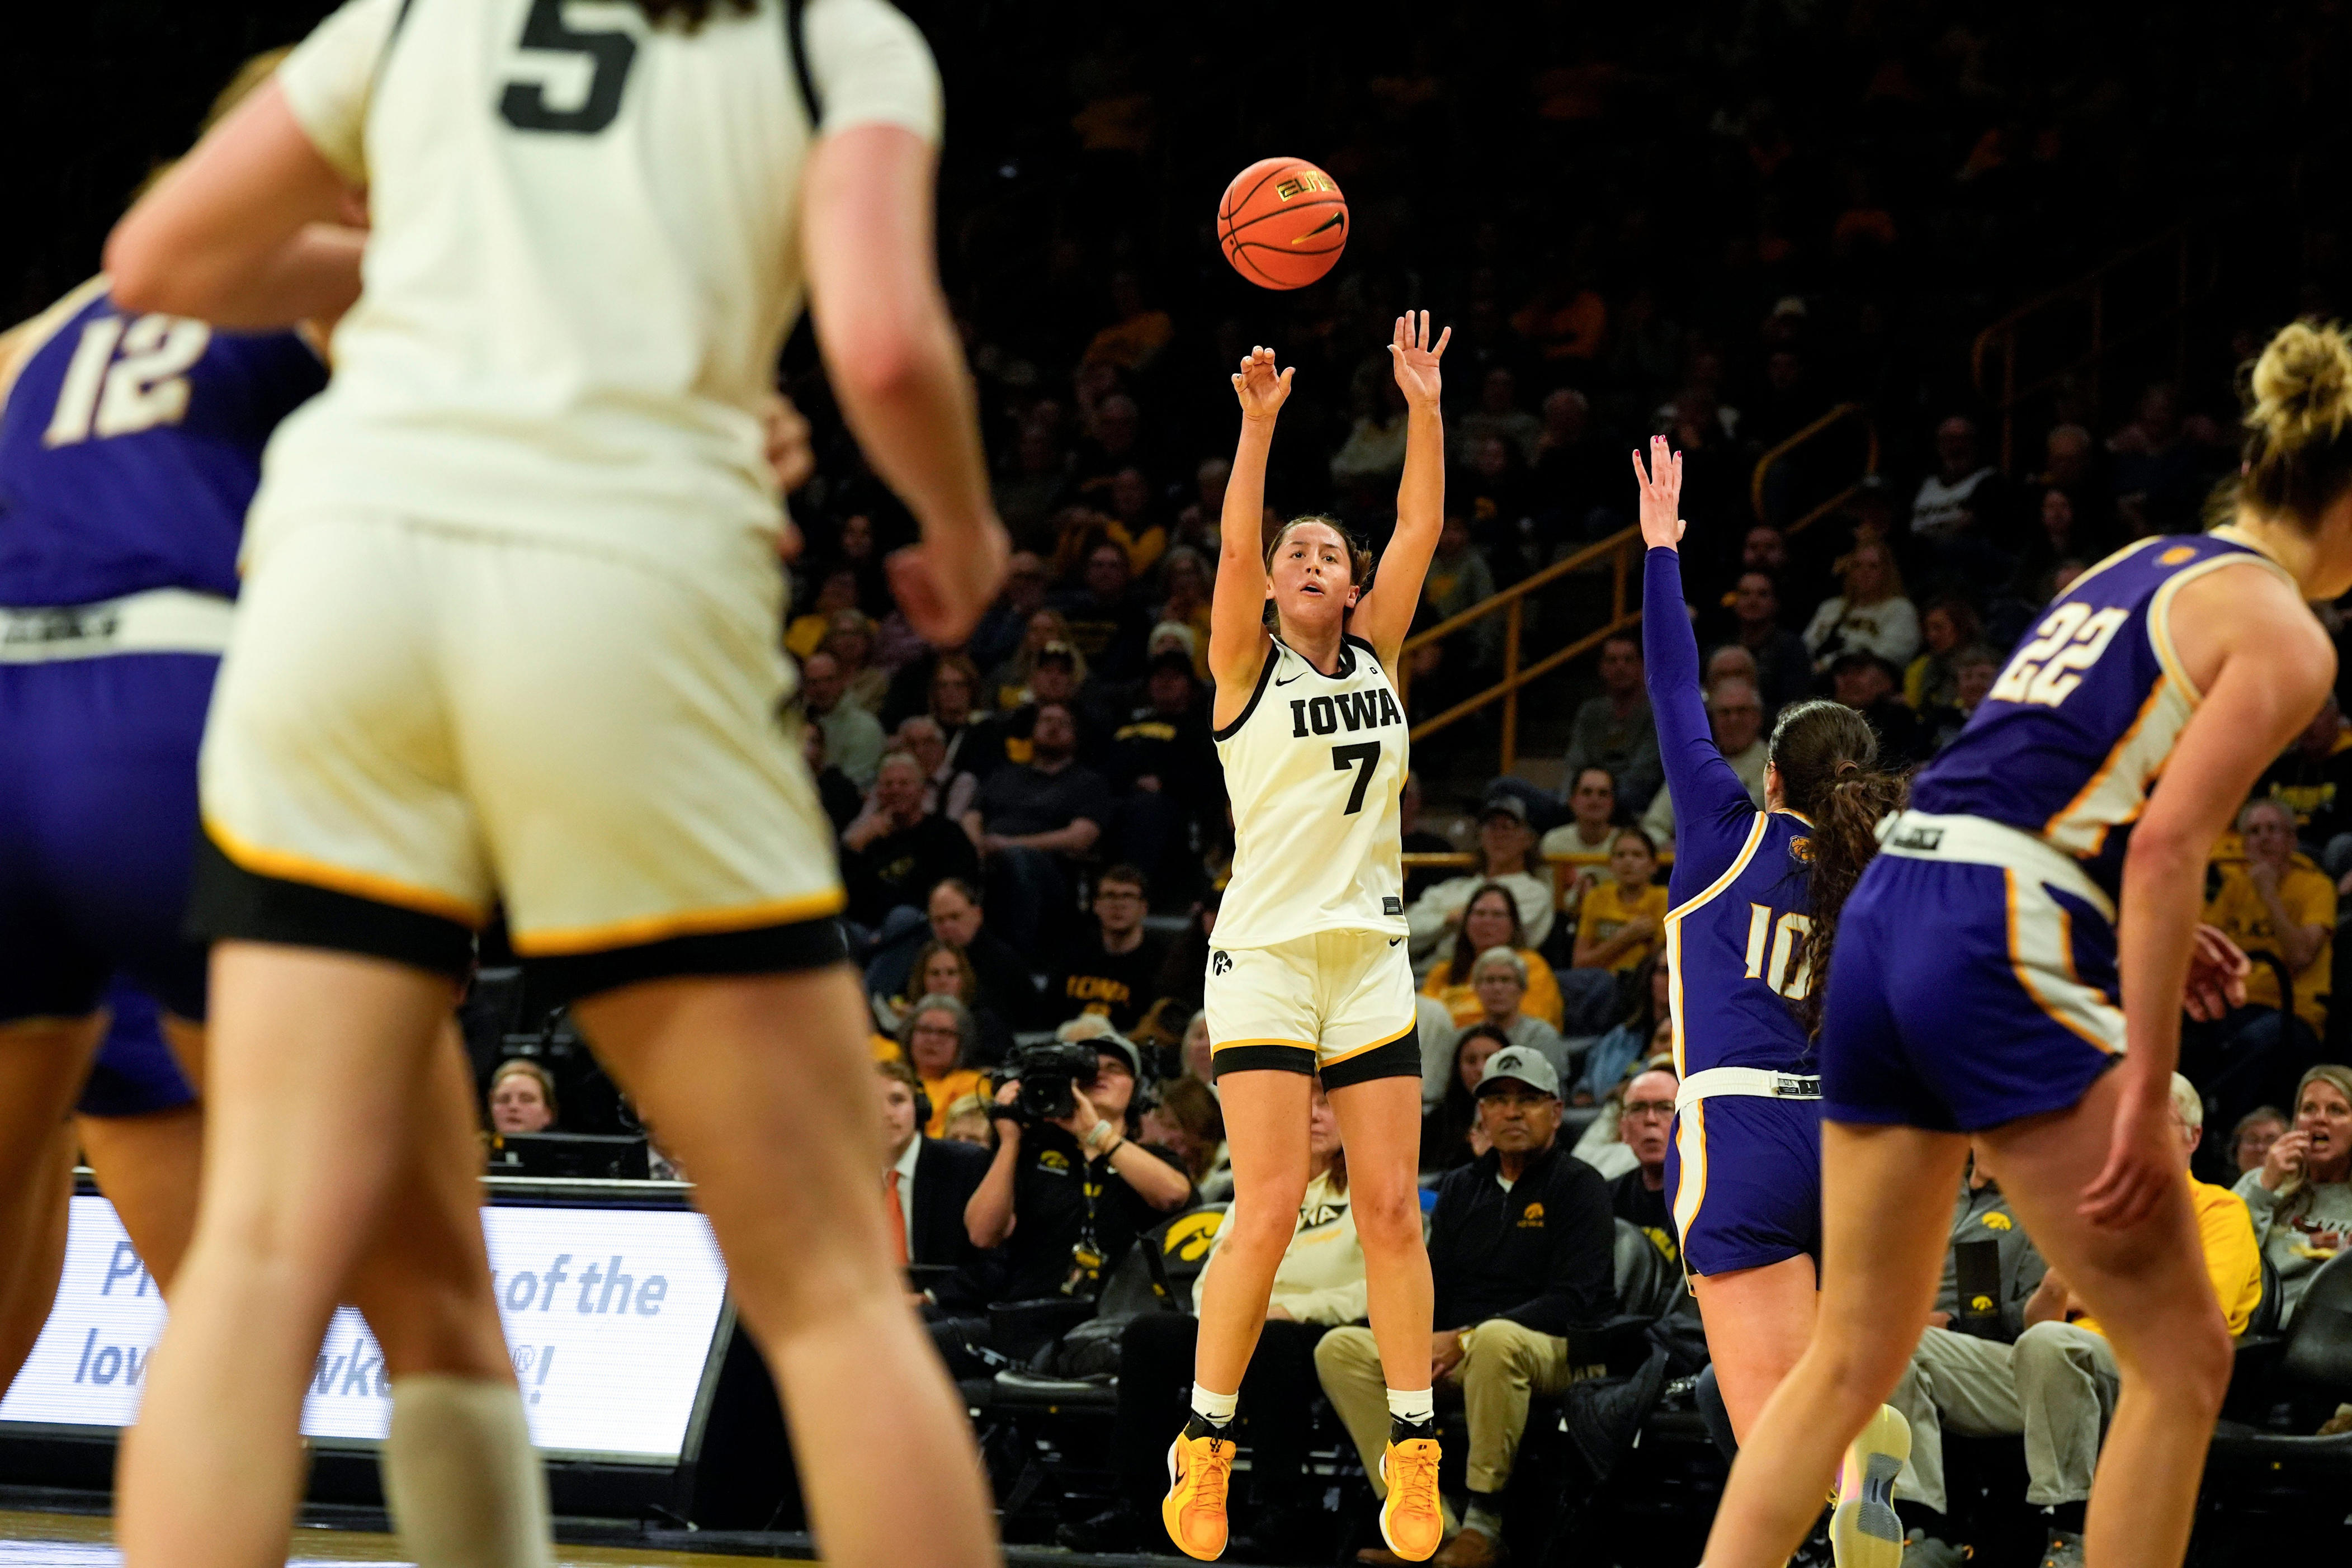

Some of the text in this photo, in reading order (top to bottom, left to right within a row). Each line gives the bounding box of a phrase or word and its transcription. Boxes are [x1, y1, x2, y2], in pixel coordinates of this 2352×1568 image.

[499, 0, 637, 135] 5
[41, 313, 211, 449] 12
[1989, 601, 2129, 709] 22
[1290, 688, 1401, 738] IOWA
[1331, 740, 1381, 816] 7
[1744, 901, 1814, 1001] 10
[1298, 1205, 1340, 1233] WA
[504, 1254, 668, 1316] of the
